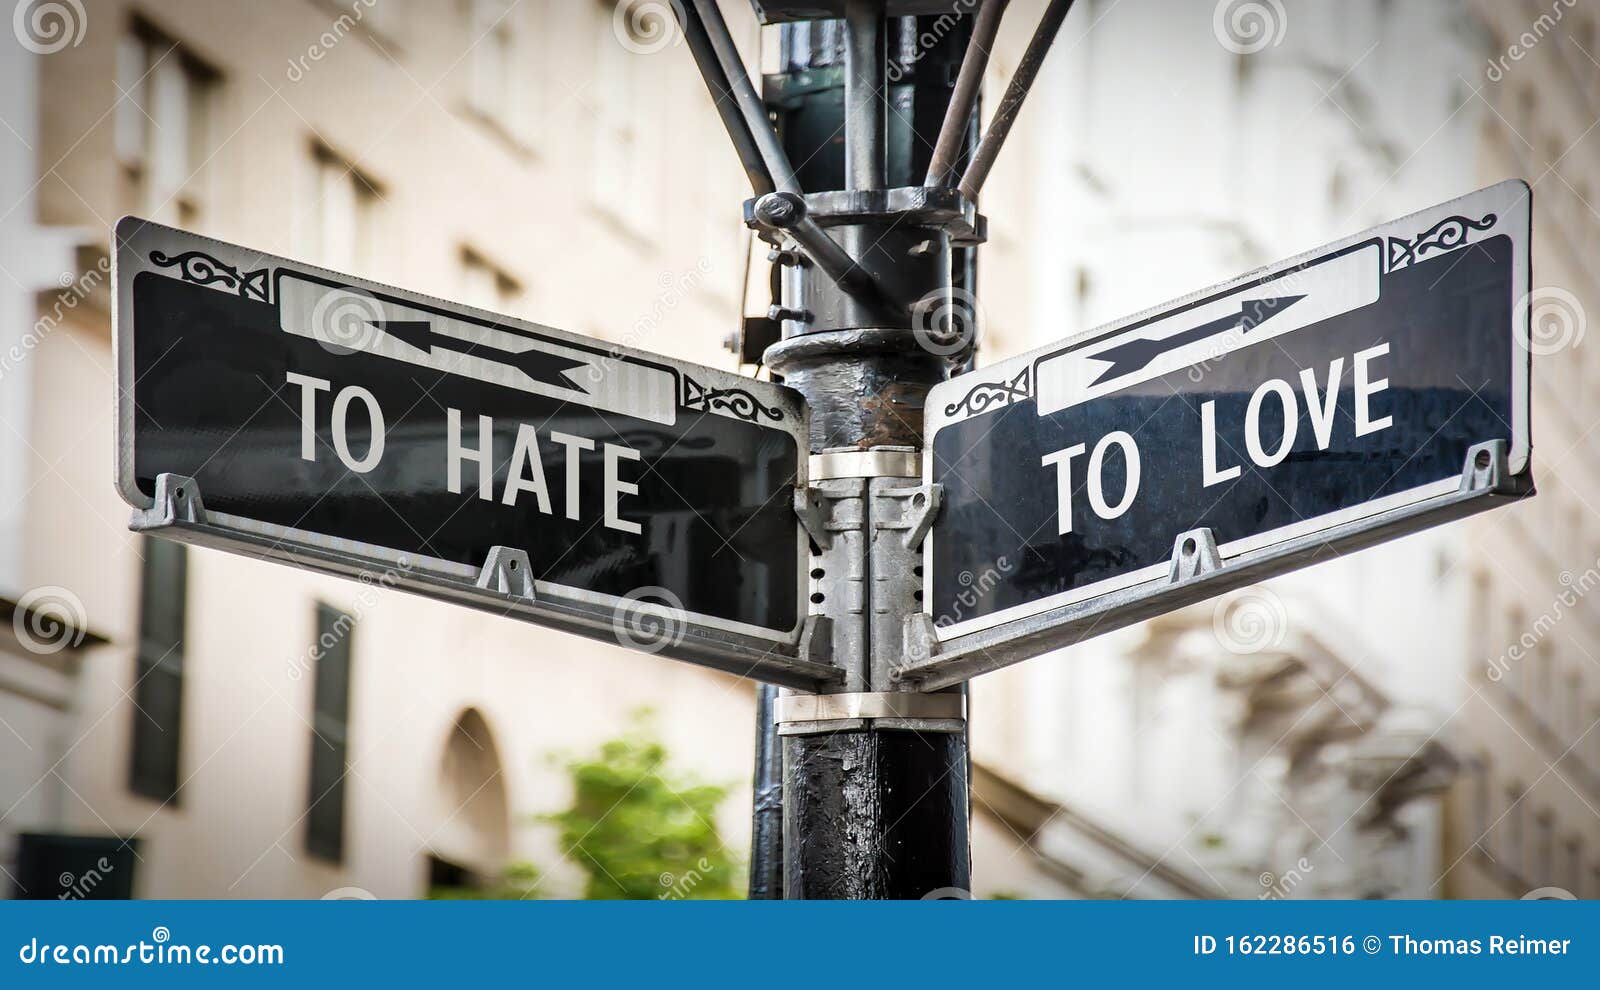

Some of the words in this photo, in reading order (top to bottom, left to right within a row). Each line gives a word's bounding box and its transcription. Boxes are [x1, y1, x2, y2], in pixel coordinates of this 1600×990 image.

[286, 371, 386, 474] TO
[447, 406, 642, 535] HATE
[1041, 430, 1141, 536] TO
[1201, 342, 1393, 488] LOVE
